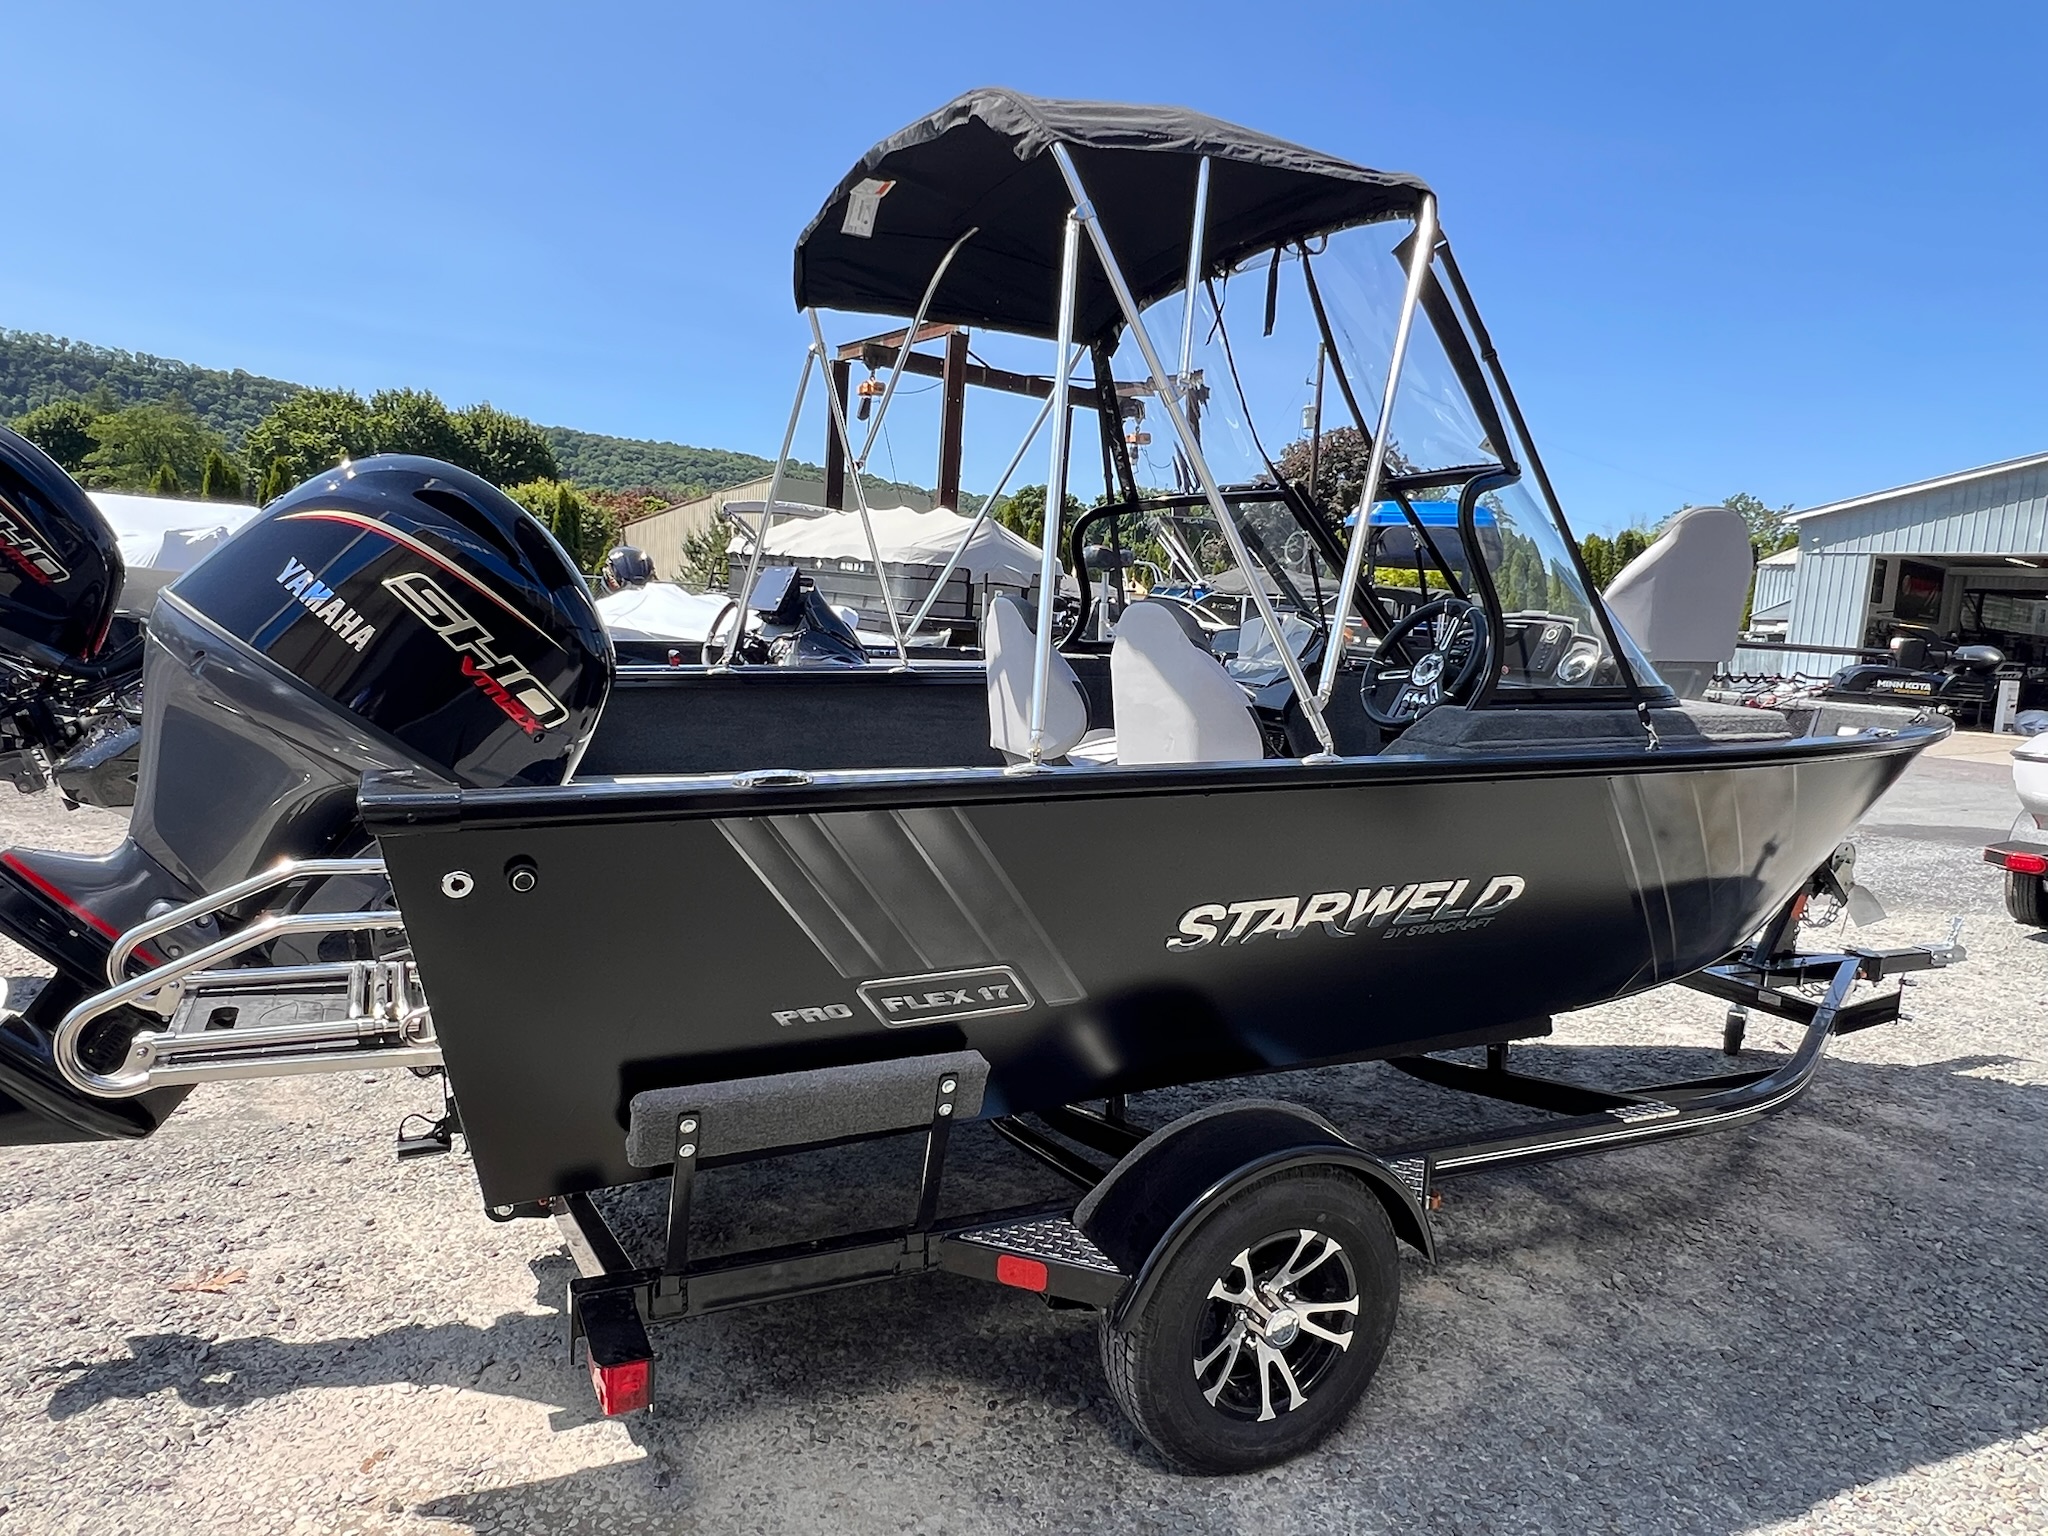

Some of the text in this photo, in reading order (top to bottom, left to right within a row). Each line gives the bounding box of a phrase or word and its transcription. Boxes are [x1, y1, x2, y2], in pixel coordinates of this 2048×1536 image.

[276, 556, 377, 652] YAMAHA
[381, 572, 570, 729] SHO
[1876, 679, 1931, 691] MINN KOTA
[1165, 874, 1526, 952] STARWELD
[1383, 916, 1496, 939] BY STARCRAFT
[771, 984, 1010, 1027] PRO FLEX 17
